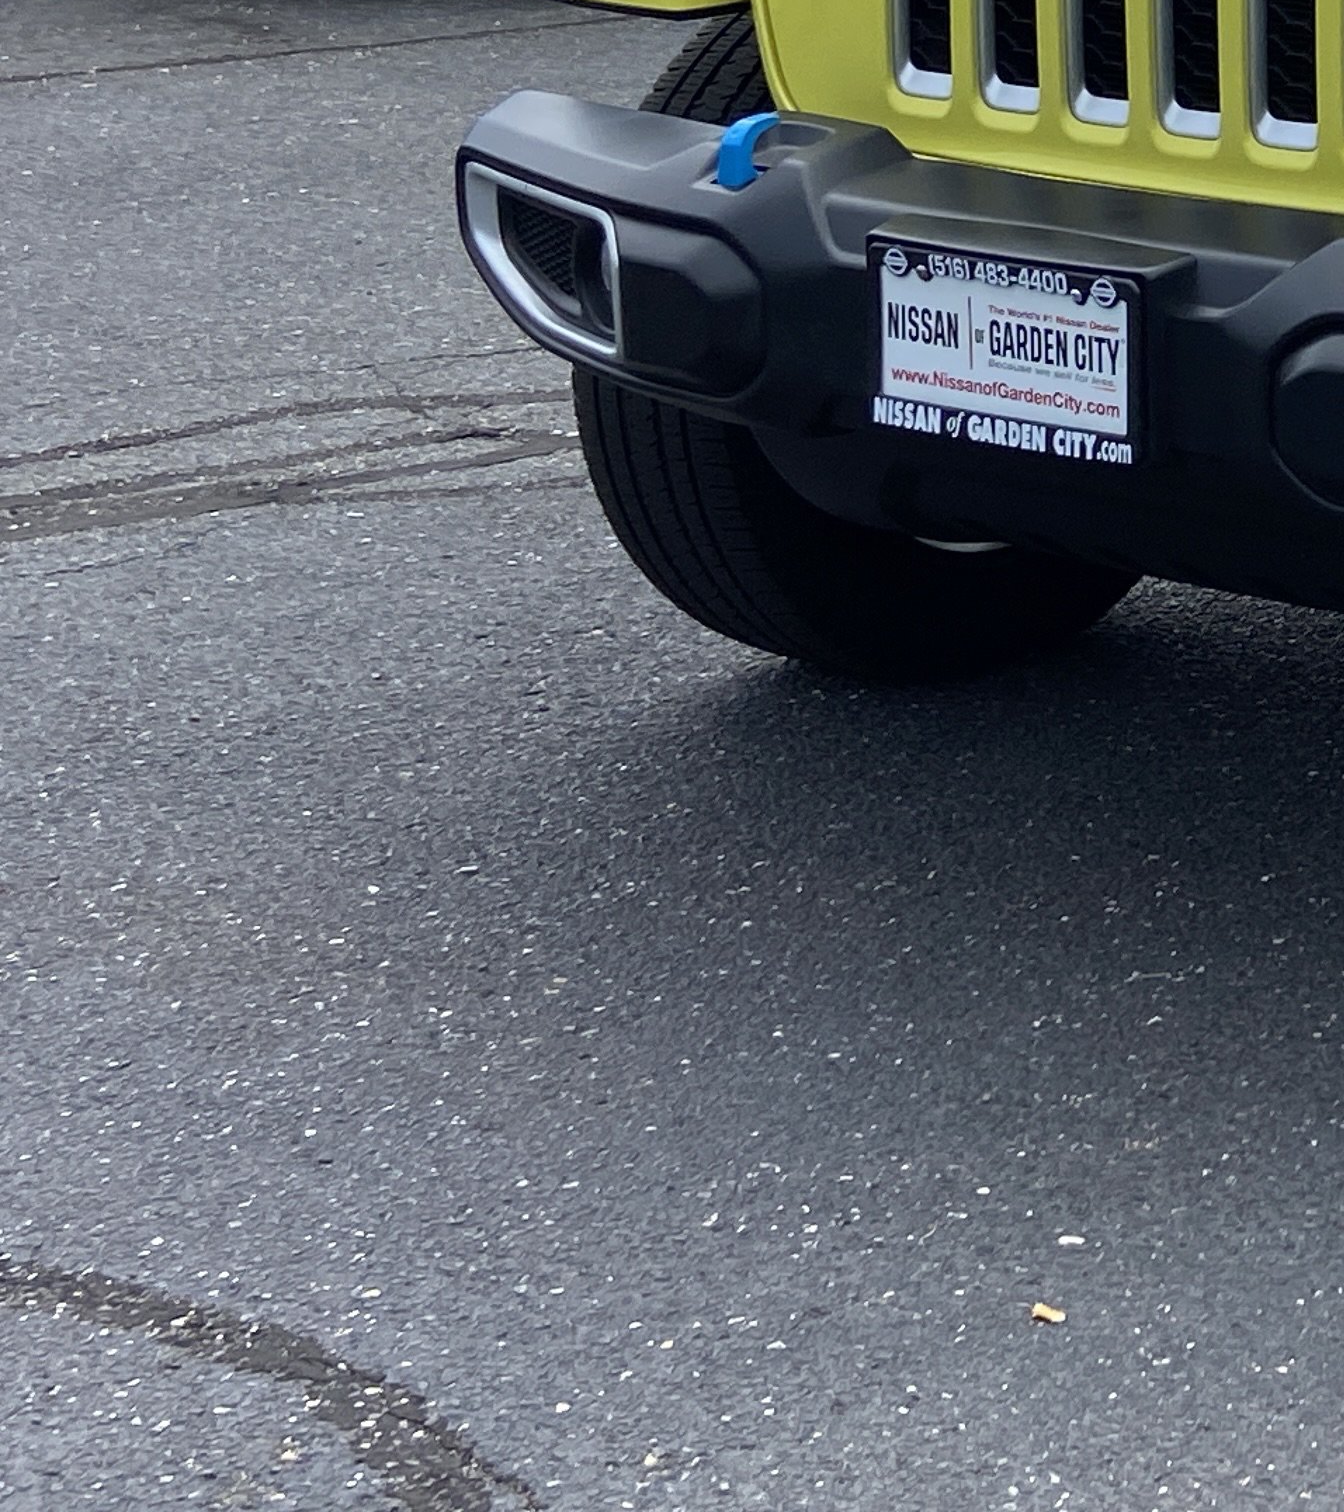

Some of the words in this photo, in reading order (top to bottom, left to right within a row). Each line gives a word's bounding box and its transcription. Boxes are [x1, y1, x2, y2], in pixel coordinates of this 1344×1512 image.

[928, 254, 971, 280] (516)
[975, 262, 1067, 295] 483-4400
[888, 301, 959, 349] NISSAN
[989, 319, 1068, 367] GARDEN
[1075, 334, 1119, 375] CITY
[891, 367, 1120, 419] www.NissanofGardenCity.com
[873, 396, 941, 434] NISSAN
[946, 412, 965, 437] of
[967, 415, 1046, 452] GARDEN
[1053, 430, 1132, 464] CITY.com
